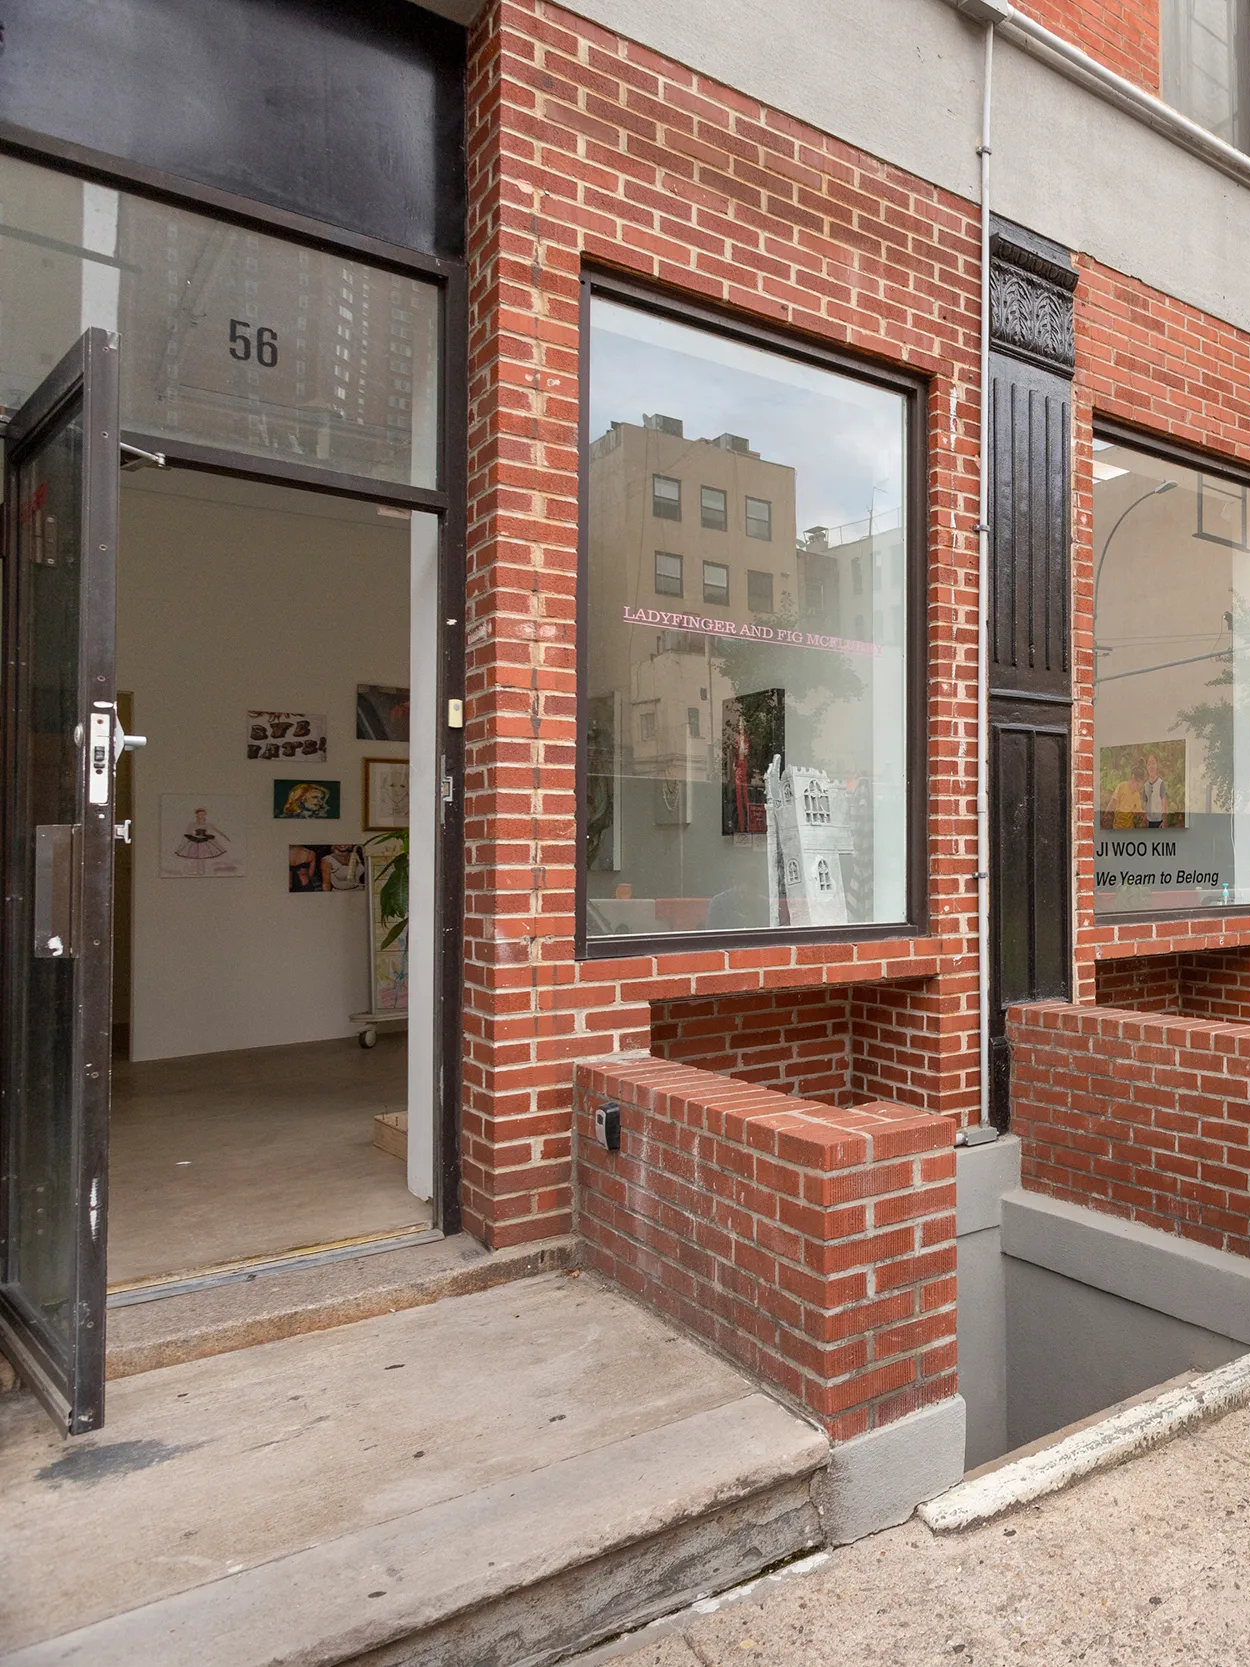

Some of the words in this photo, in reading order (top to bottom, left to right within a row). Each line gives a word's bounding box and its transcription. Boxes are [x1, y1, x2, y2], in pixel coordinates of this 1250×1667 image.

[229, 318, 278, 368] 56
[623, 605, 737, 634] LADYFINGER
[740, 624, 773, 639] AND
[776, 629, 803, 643] FIG
[806, 633, 885, 654] MCFLURRY
[1096, 842, 1109, 857] JI
[1112, 841, 1147, 857] WOO
[1151, 842, 1176, 857] KIM
[1096, 871, 1117, 886] We
[1120, 871, 1156, 886] Yearn
[1160, 871, 1172, 884] to
[1176, 870, 1219, 886] Belong
